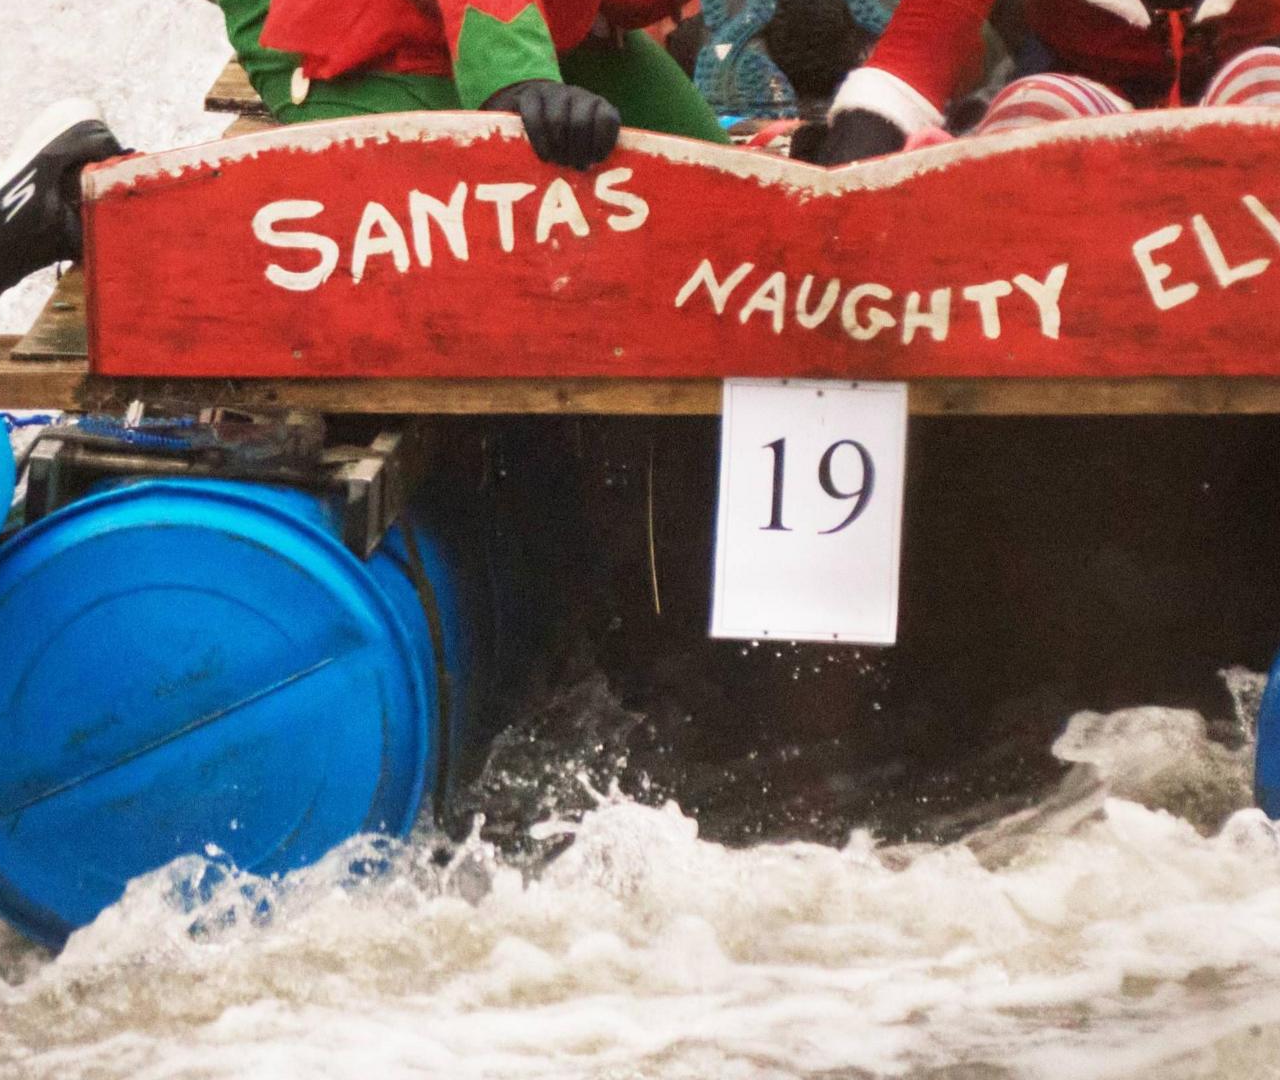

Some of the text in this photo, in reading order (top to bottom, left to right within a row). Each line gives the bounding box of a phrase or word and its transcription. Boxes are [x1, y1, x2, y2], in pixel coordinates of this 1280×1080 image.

[250, 165, 651, 292] SANTAS
[673, 257, 1070, 345] NAUGHTY
[759, 436, 875, 536] 19
